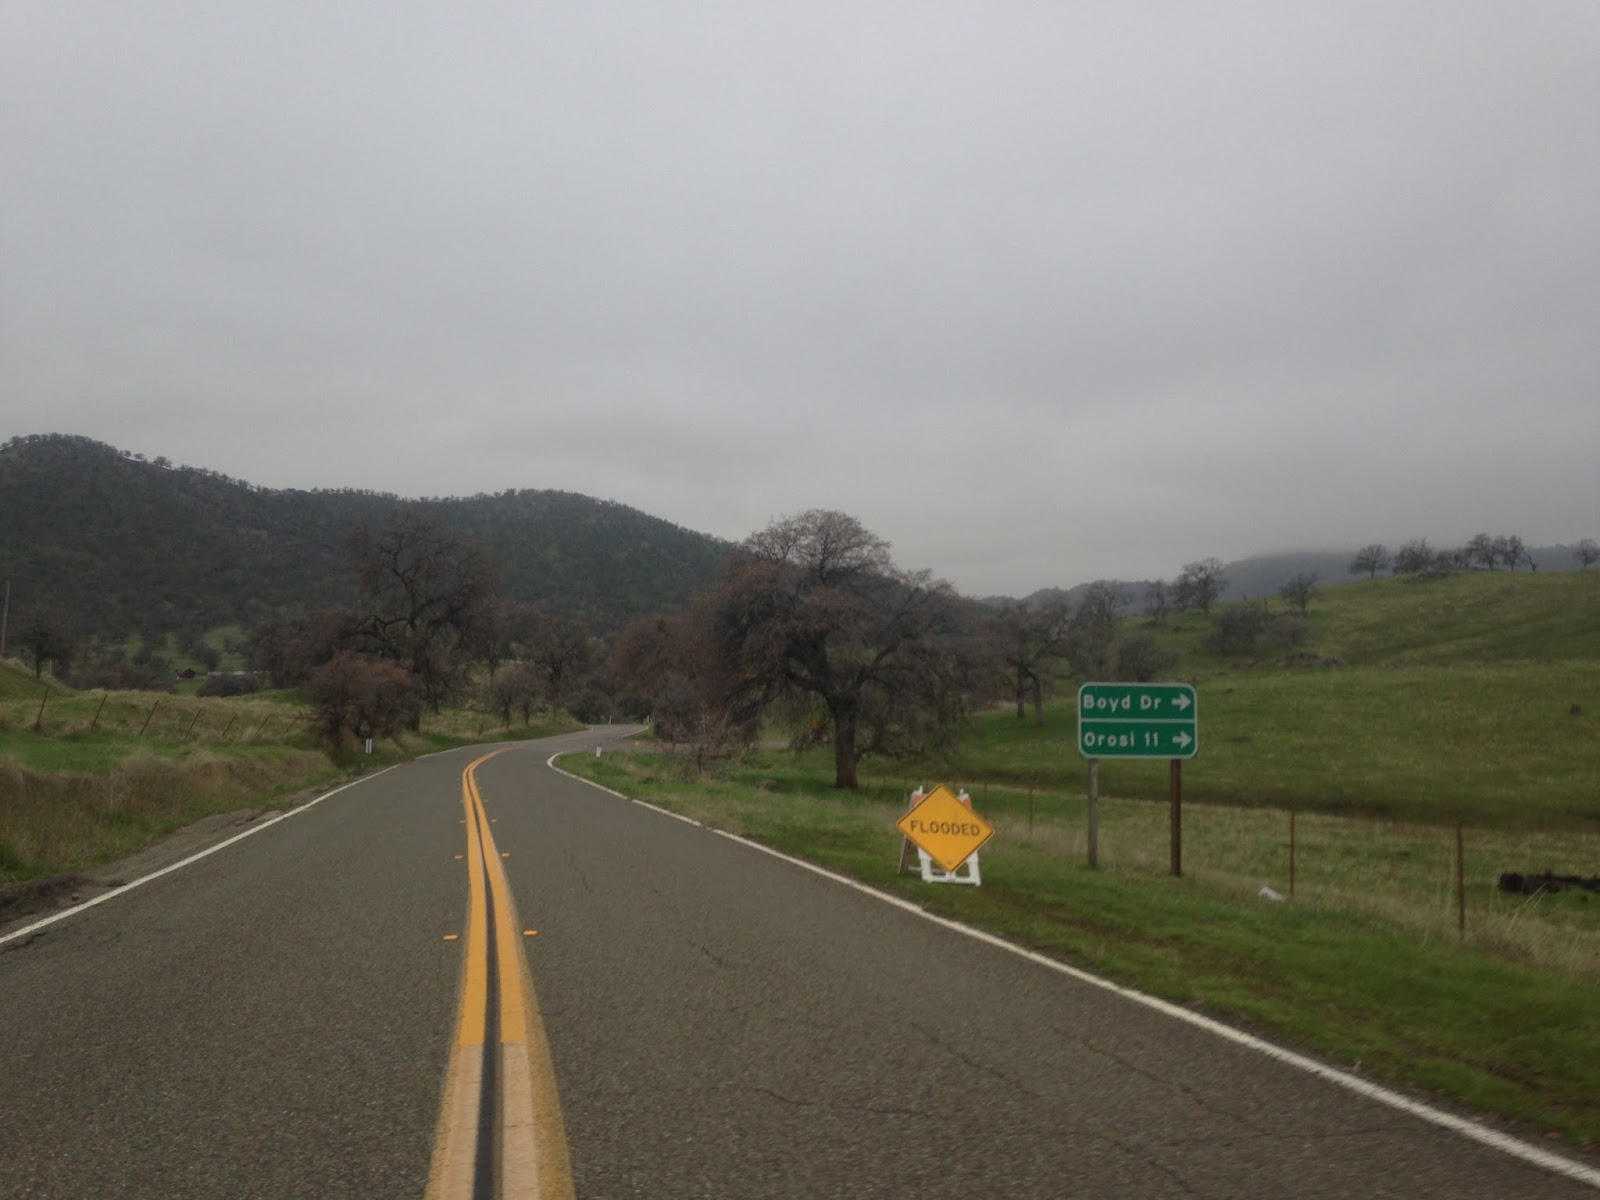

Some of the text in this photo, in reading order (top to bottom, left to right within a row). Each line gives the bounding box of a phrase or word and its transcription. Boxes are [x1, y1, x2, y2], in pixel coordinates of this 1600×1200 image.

[1083, 694, 1162, 713] Boyd Dr
[1084, 731, 1159, 747] Orosi 11
[910, 820, 980, 837] FLOODED
